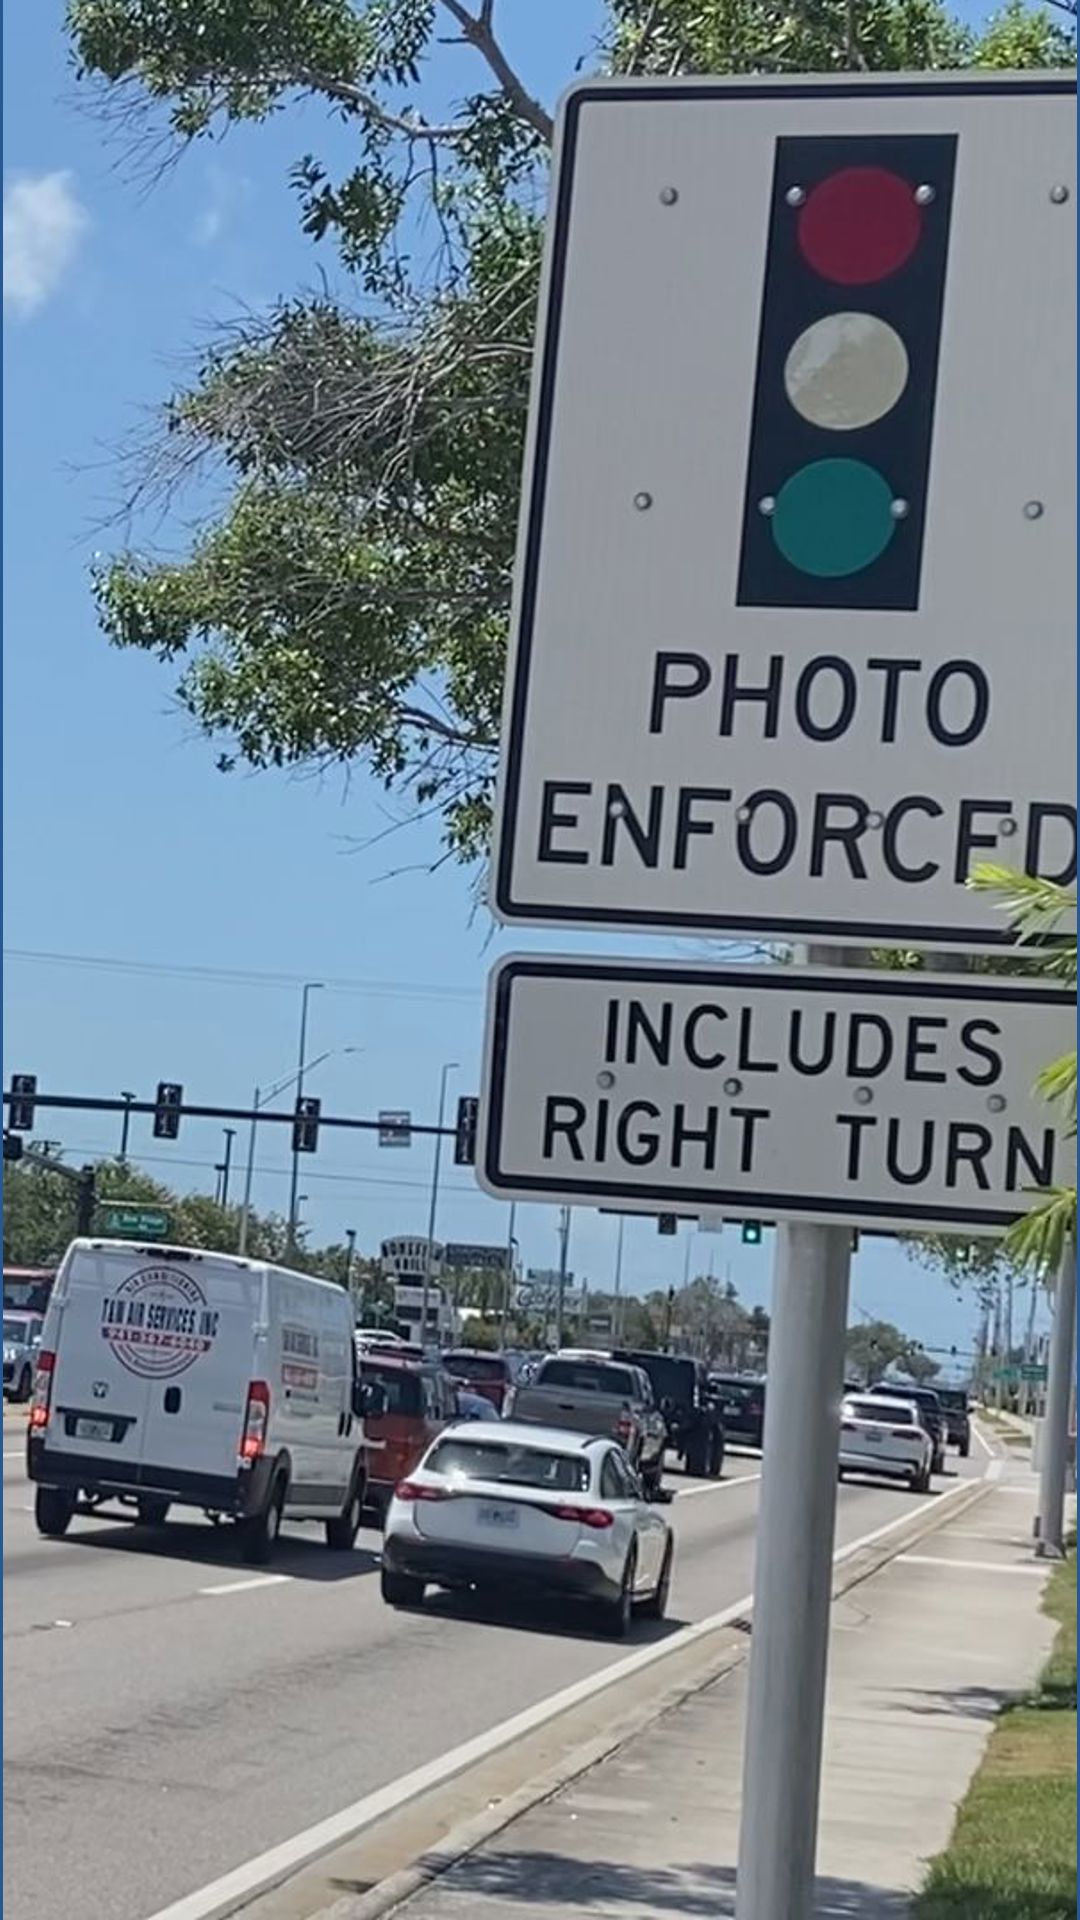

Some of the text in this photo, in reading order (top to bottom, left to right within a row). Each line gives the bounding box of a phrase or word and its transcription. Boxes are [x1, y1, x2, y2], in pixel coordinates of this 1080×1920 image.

[649, 651, 990, 747] PHOTO
[537, 780, 1076, 886] ENFORCED
[604, 999, 1004, 1086] INCLUDES
[542, 1096, 1056, 1192] RIGHT TURN
[126, 1301, 145, 1327] AIR
